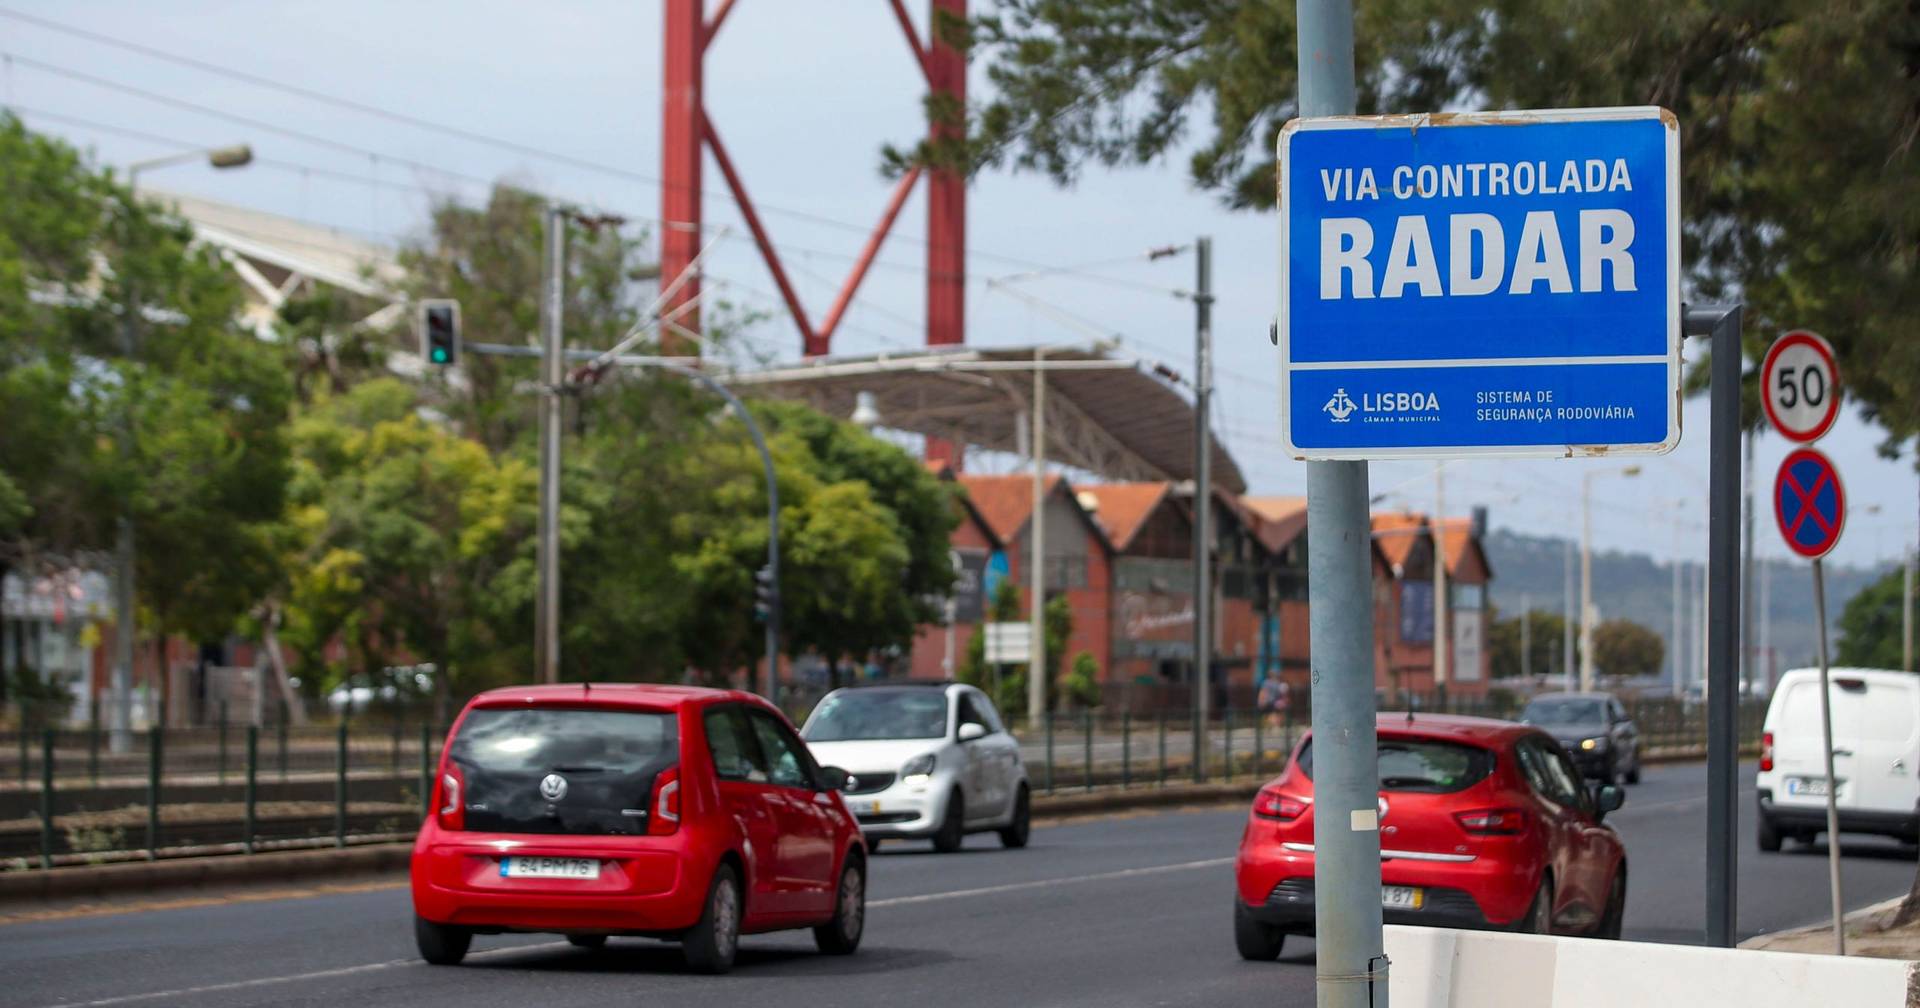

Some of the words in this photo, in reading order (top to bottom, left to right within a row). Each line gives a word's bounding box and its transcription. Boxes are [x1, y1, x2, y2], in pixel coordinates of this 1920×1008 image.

[1320, 168, 1379, 201] VIA
[1393, 158, 1633, 199] CONTROLADA
[1320, 208, 1638, 300] RADAR
[1476, 391, 1532, 404] SISTEMA
[1537, 390, 1553, 403] DE
[1778, 364, 1824, 408] 50
[1363, 392, 1440, 412] LISBOA
[1476, 408, 1552, 423] SEGURANÇA
[1557, 405, 1635, 420] RODOVIÁRIA
